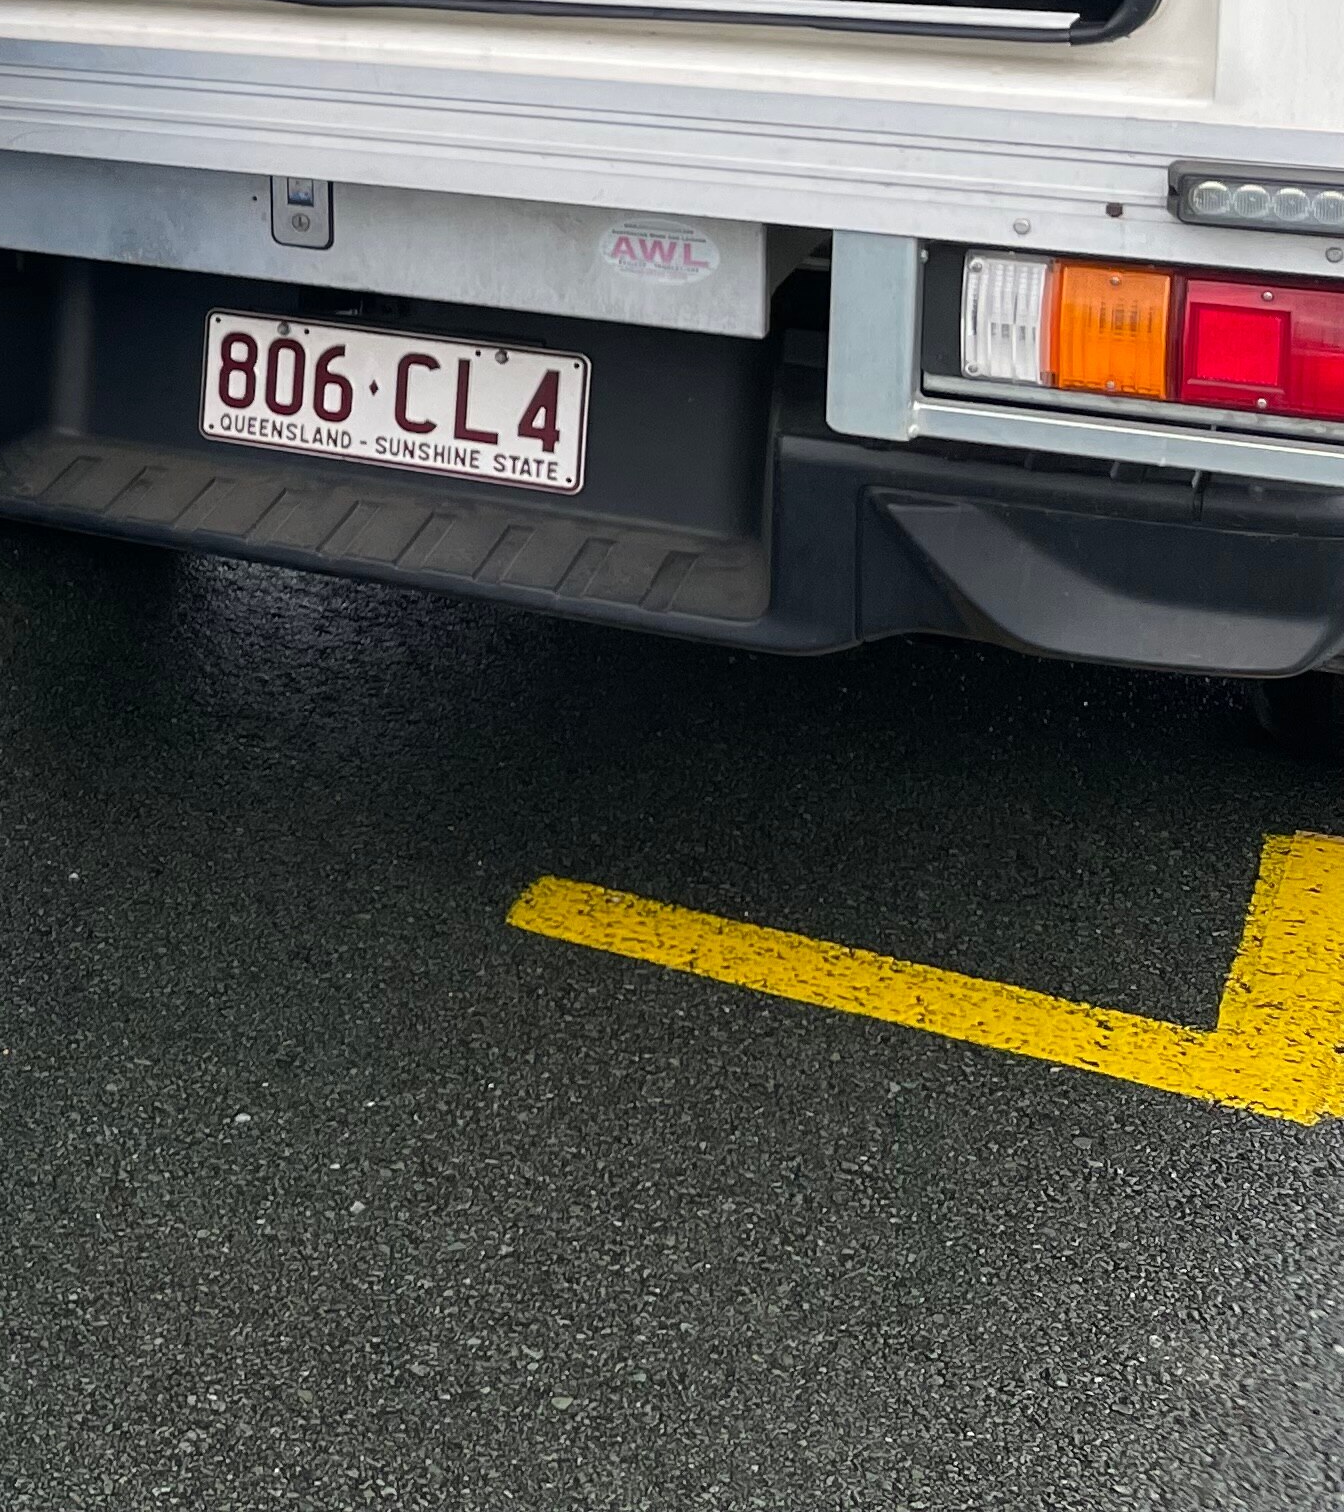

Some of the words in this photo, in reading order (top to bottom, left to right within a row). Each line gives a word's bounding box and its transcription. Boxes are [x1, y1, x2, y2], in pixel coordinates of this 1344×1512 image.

[611, 236, 709, 268] AWL
[220, 412, 352, 449] QUEENSLAND
[375, 437, 480, 470] SUNSHINE
[493, 454, 559, 480] STATE
